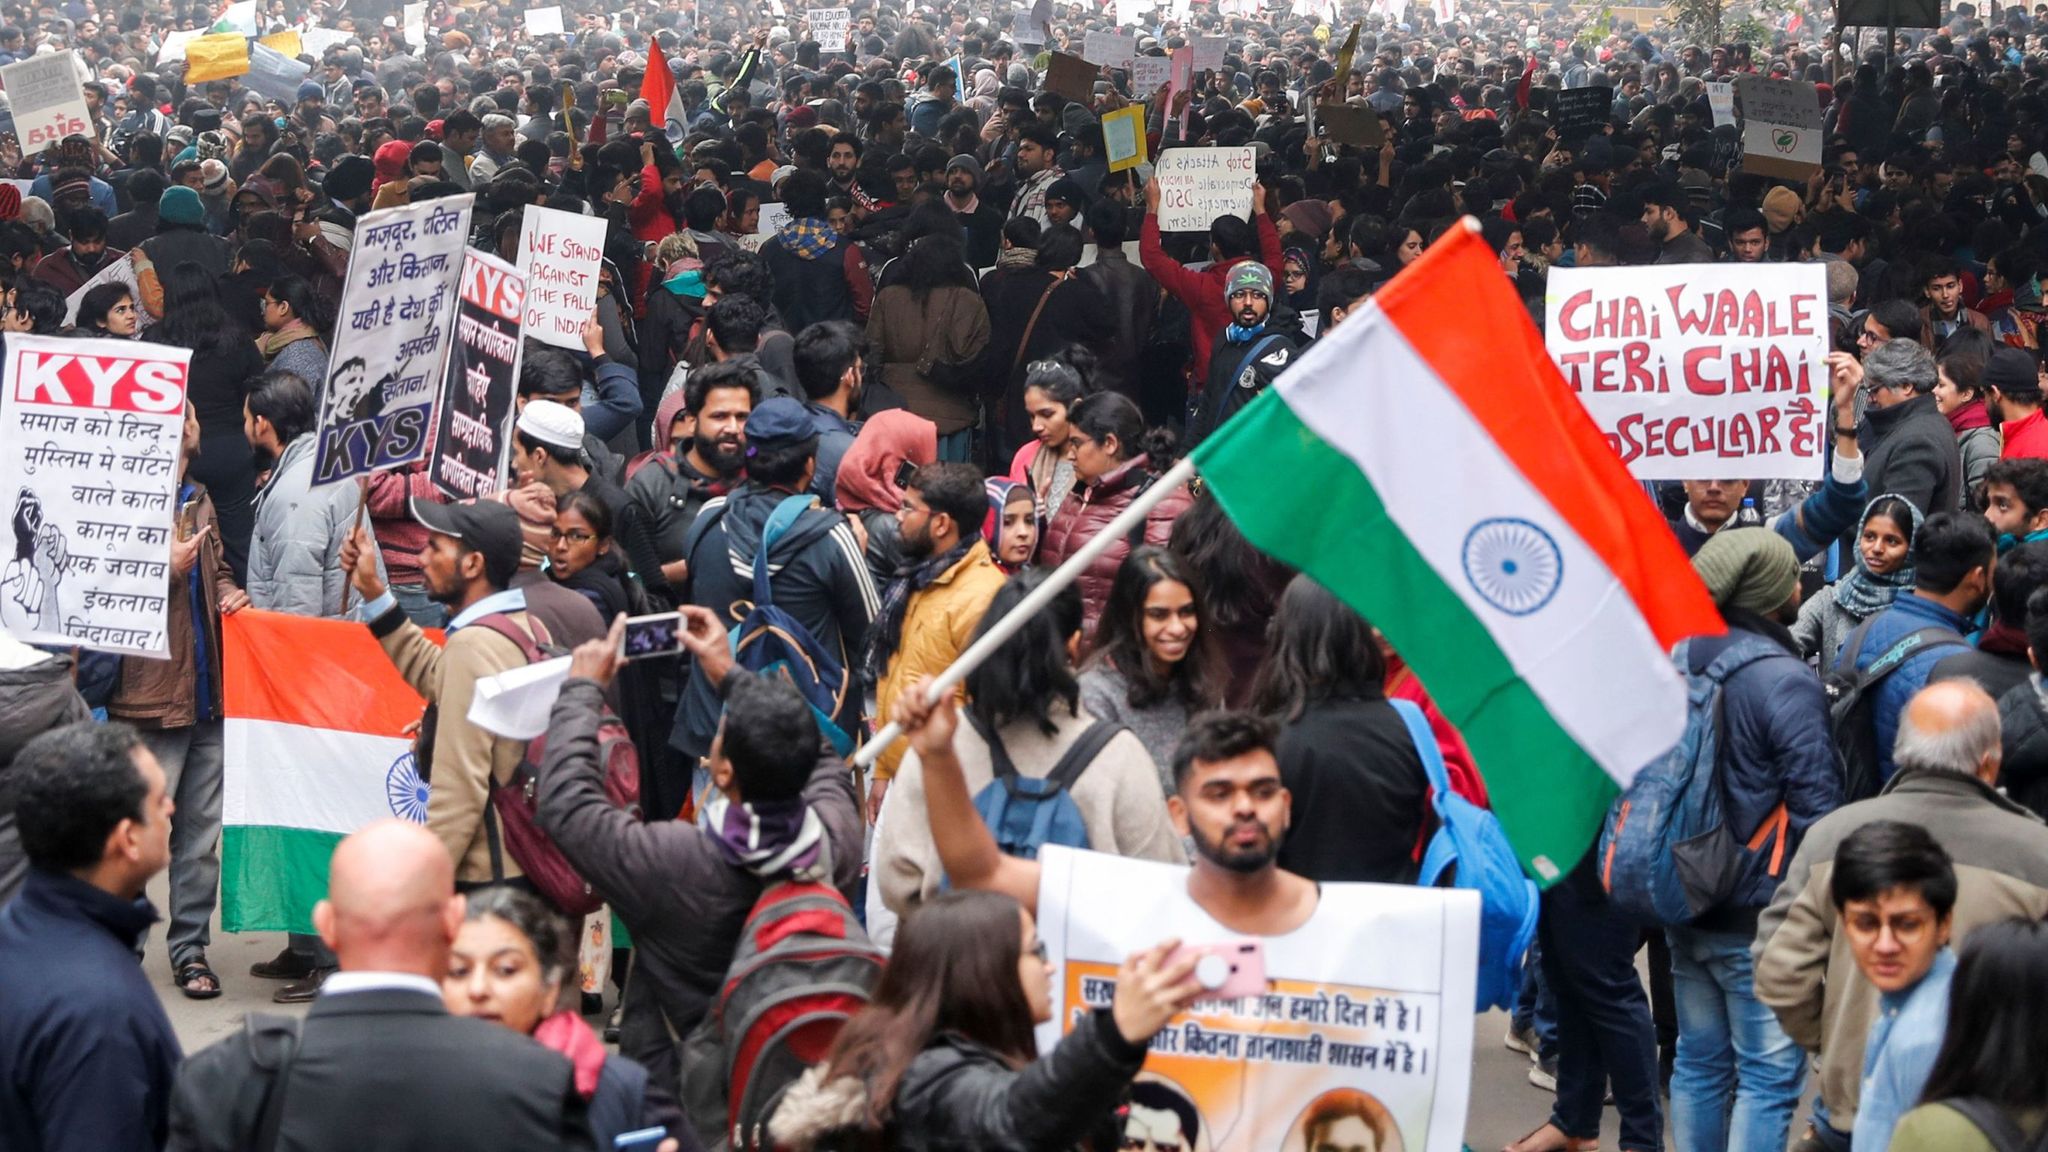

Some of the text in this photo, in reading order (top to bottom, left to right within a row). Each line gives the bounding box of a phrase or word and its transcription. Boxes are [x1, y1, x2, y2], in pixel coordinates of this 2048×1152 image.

[424, 206, 460, 235] दलित
[529, 231, 600, 262] WE STAND
[367, 258, 396, 288] और
[462, 256, 522, 320] KYS
[530, 262, 588, 287] AGAINST
[352, 299, 381, 330] यही
[383, 296, 395, 326] है
[400, 294, 426, 321] देश
[531, 287, 592, 311] THE FALL
[527, 308, 546, 328] OF
[396, 326, 440, 362] असली
[18, 351, 183, 413] KYS
[20, 412, 78, 434] समाज
[84, 411, 113, 436] को
[25, 441, 93, 475] मुस्लिम
[318, 408, 424, 482] KYS
[72, 481, 170, 512] वाले काले
[77, 519, 169, 552] कानून का
[67, 554, 167, 580] एक जवाब
[84, 590, 165, 614] इंकलाब
[1289, 991, 1329, 1024] हमारे
[1335, 994, 1366, 1027] दिल
[1374, 998, 1388, 1029] में
[1184, 1021, 1239, 1058] कितना
[1246, 1033, 1322, 1064] तानाशाही
[1328, 1042, 1379, 1069] शासन
